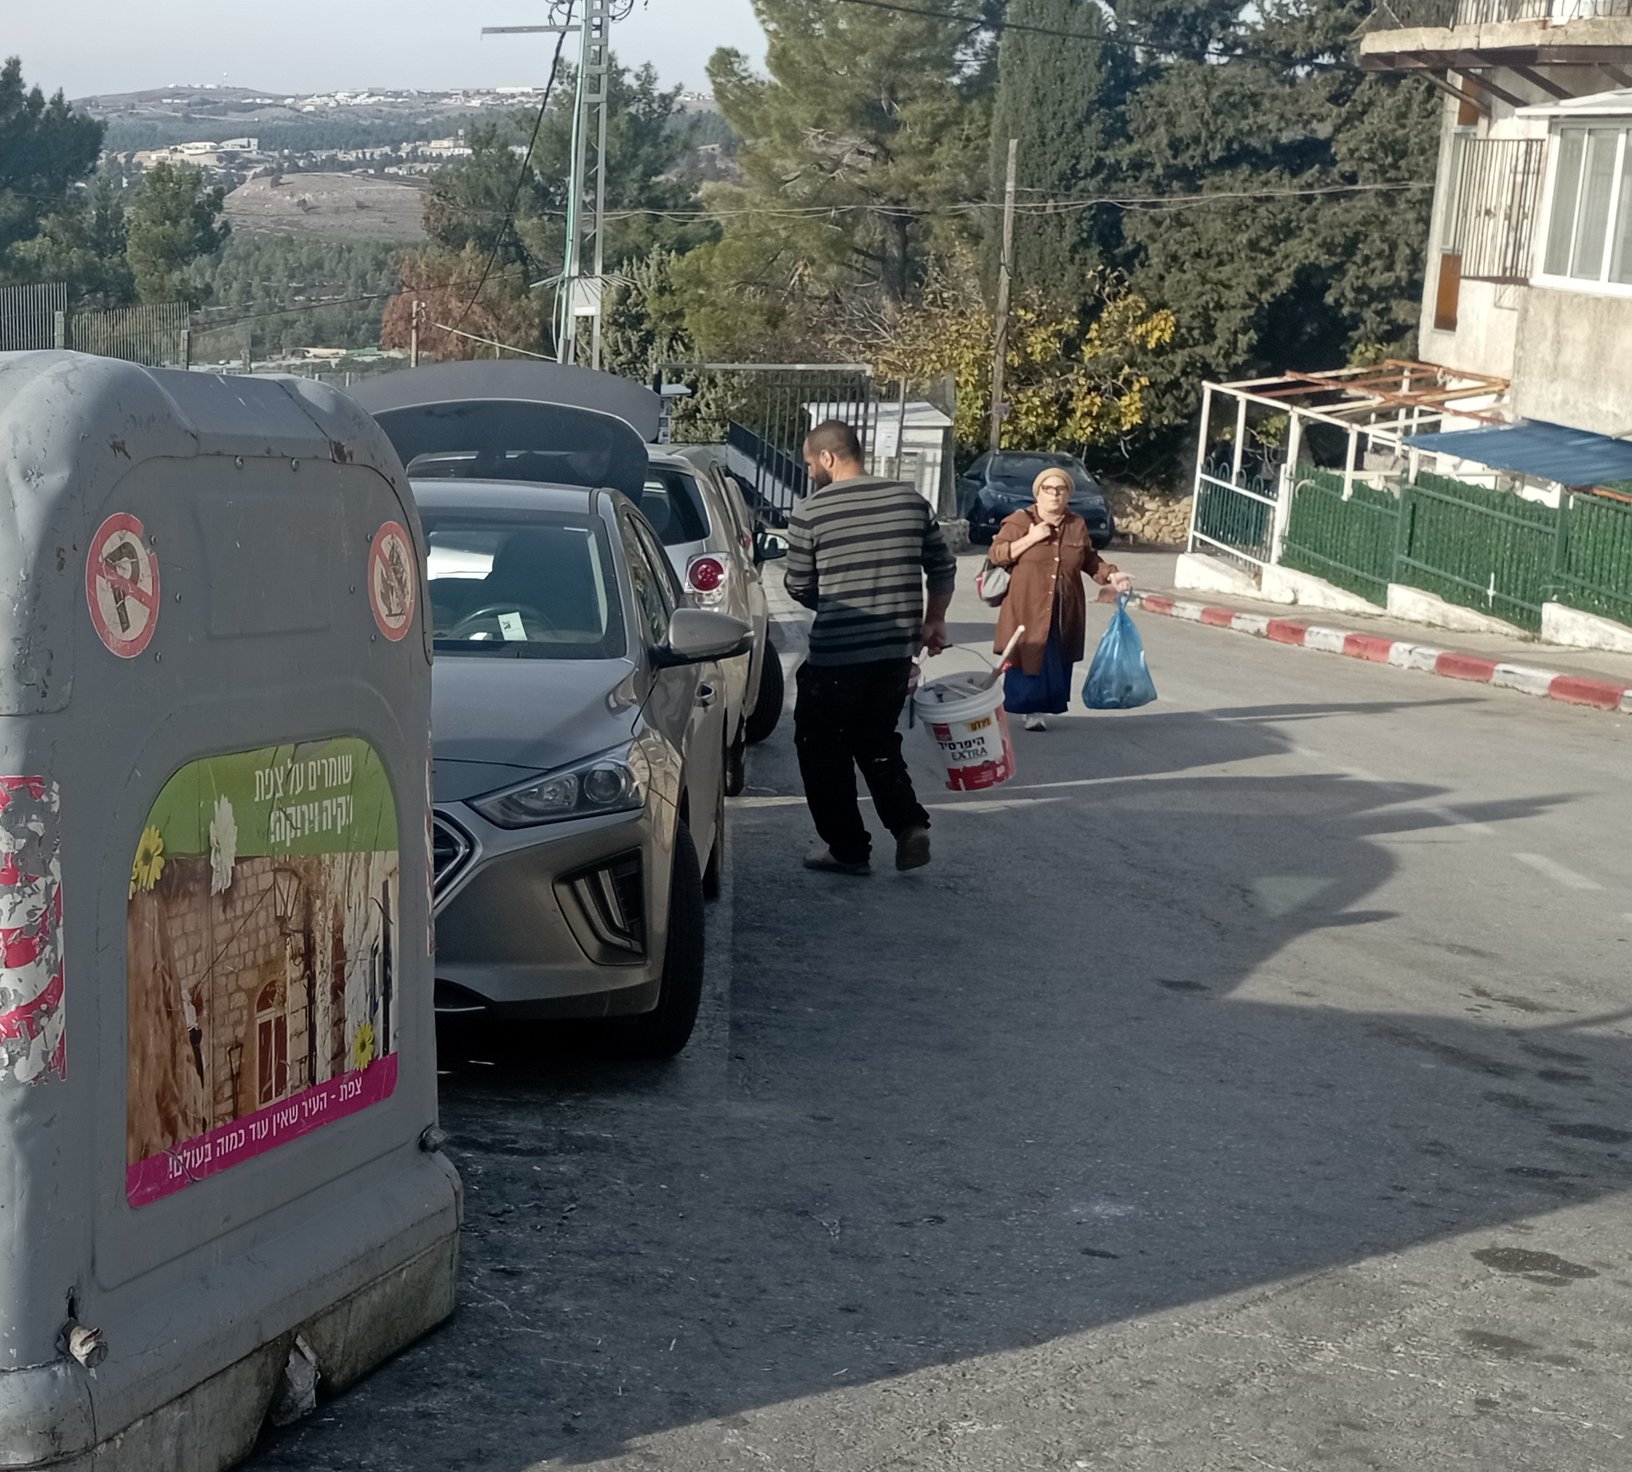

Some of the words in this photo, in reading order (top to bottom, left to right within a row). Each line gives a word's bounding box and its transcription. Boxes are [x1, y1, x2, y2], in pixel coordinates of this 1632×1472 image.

[951, 747, 988, 761] EXTRA
[254, 766, 284, 802] צפת
[287, 758, 304, 796] על
[309, 754, 352, 791] שומרים
[270, 802, 319, 847] וירוקה!
[323, 795, 353, 835] נקיה
[302, 1092, 327, 1117] העיר
[339, 1077, 363, 1102] צפת
[249, 1118, 269, 1141] עוד
[272, 1107, 298, 1136] שאין
[216, 1129, 245, 1158] כמוה
[168, 1147, 213, 1179] בעולם!
